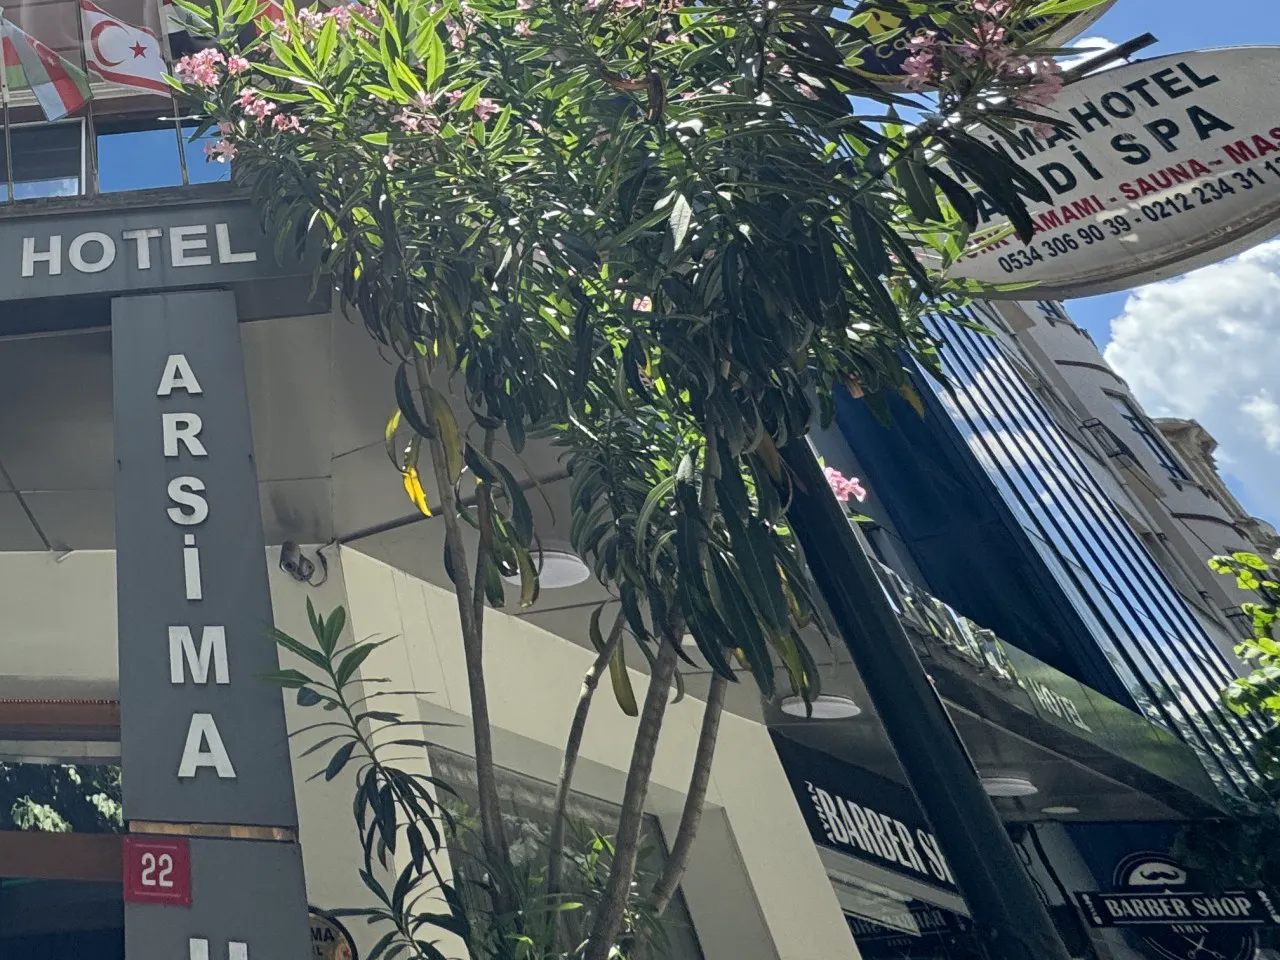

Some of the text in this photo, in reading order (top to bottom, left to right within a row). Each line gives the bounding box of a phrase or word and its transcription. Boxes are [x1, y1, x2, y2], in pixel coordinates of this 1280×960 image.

[1068, 62, 1220, 133] HOTEL
[1110, 105, 1235, 166] SPA
[998, 245, 1044, 274] 0534
[1041, 234, 1079, 258] 306
[1077, 224, 1105, 245] 90
[1103, 215, 1131, 236] 39
[1141, 193, 1196, 223] 0212
[1192, 177, 1236, 205] 234
[1232, 167, 1266, 190] 31
[1016, 194, 1106, 241] AMAMI
[1119, 158, 1213, 201] SAUNA
[21, 223, 258, 277] HOTEL
[1026, 676, 1093, 734] HOTEL
[815, 787, 929, 874] BARBER
[141, 851, 175, 888] 22
[1104, 897, 1252, 918] BARBER SHOP
